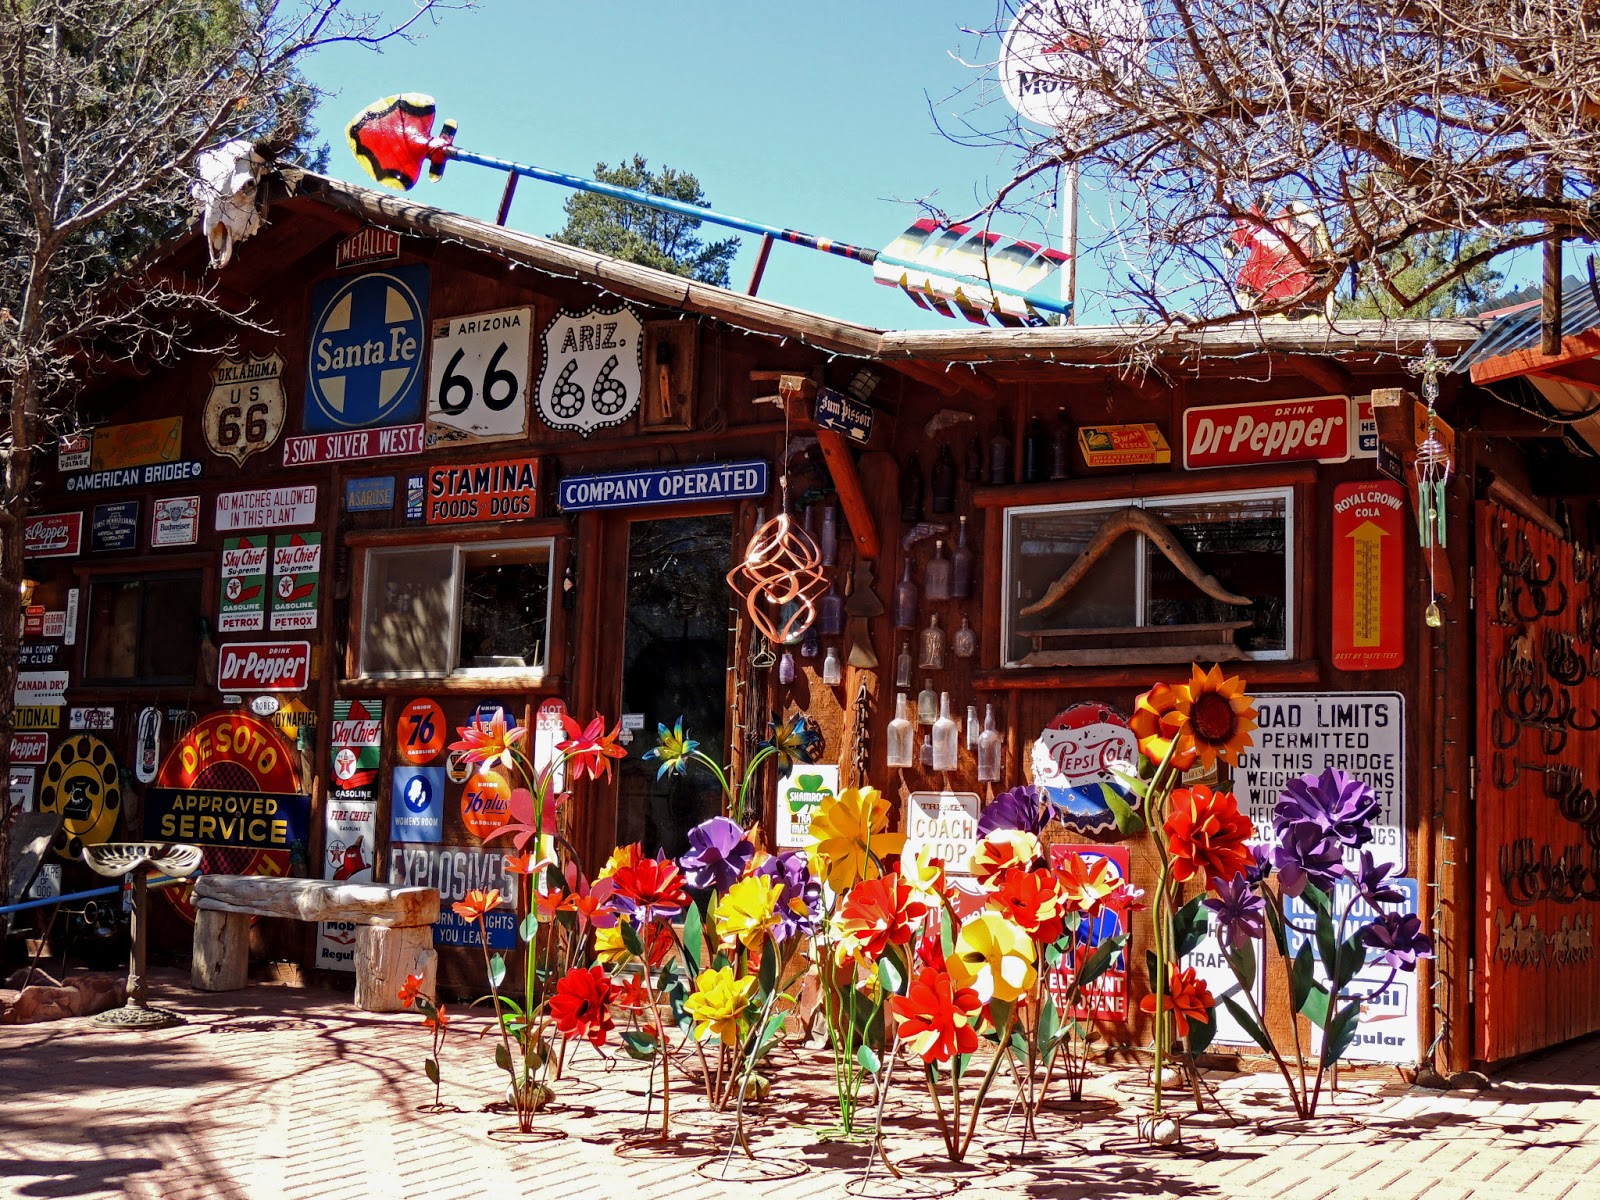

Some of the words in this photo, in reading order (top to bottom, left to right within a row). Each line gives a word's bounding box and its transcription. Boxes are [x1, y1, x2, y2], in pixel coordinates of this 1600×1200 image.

[342, 228, 394, 260] METALLIC
[458, 314, 521, 335] ARIZONA
[560, 322, 627, 353] ARIZ.
[317, 337, 385, 371] Santa
[389, 326, 417, 362] Fe
[218, 362, 278, 382] OKLAHOMA
[438, 341, 519, 416] 66
[551, 354, 628, 418] 66
[1274, 405, 1315, 417] DRINK
[219, 403, 268, 446] 66
[292, 439, 317, 463] SON
[325, 432, 368, 459] SILVER
[379, 427, 416, 452] WEST
[60, 460, 87, 468] VOLTAGE
[75, 469, 140, 492] AMERICAN
[145, 462, 191, 483] BRIDGE
[408, 477, 424, 489] PULL
[431, 463, 536, 498] STAMINA
[565, 478, 651, 504] COMPANY
[658, 468, 758, 496] OPERATED
[218, 495, 229, 511] NO
[231, 492, 271, 510] MATCHES
[274, 488, 315, 506] ALLOWED
[432, 499, 478, 520] FOODS
[491, 495, 530, 516] DOGS
[1334, 492, 1366, 513] ROYAL
[1367, 491, 1403, 511] CROWN
[230, 512, 240, 527] IN
[243, 510, 263, 526] THIS
[266, 507, 297, 524] PLANT
[1355, 508, 1380, 517] COLA
[31, 521, 68, 544] Pepper
[160, 523, 190, 531] Budweiser
[224, 552, 240, 569] Sky
[242, 549, 267, 565] Chief
[275, 549, 292, 567] Sky
[294, 546, 319, 563] Chief
[223, 603, 261, 612] GASOLINE
[275, 601, 314, 610] GASOLINE
[45, 614, 64, 623] GENERAL
[223, 618, 259, 628] PETROX
[275, 616, 312, 626] PETROX
[35, 645, 59, 653] COUNTY
[31, 655, 53, 664] CLUB
[17, 681, 47, 690] CANADA
[50, 680, 65, 690] DRY
[255, 702, 275, 711] ROBES
[541, 705, 562, 714] HOT
[1257, 704, 1301, 728] OAD
[1317, 704, 1389, 728] LIMITS
[275, 711, 316, 728] DYNAFUEL
[406, 711, 436, 746] 76
[538, 720, 563, 729] COLD
[332, 720, 351, 746] Sky
[351, 720, 382, 742] Chief
[1262, 733, 1369, 748] PERMITTED
[10, 738, 46, 759] Pepper
[1238, 753, 1261, 769] ON
[1272, 753, 1312, 769] THIS
[1324, 753, 1394, 770] BRIDGE
[335, 790, 372, 798] GASOLINE
[465, 791, 484, 814] 76
[481, 794, 509, 814] plus
[172, 795, 278, 815] APPROVED
[331, 810, 348, 820] FIRE
[350, 811, 373, 822] CHIEF
[395, 817, 420, 826] WOMEN'S
[421, 817, 438, 827] ROOM
[797, 813, 812, 823] TRA
[161, 814, 288, 844] SERVICE
[791, 824, 809, 834] MAS
[916, 819, 973, 839] COACH
[922, 843, 967, 863] TOP
[389, 848, 514, 903] EXPLOSIVES
[326, 921, 356, 931] Mob
[485, 915, 514, 930] IGHTS
[440, 929, 459, 943] YOU
[321, 947, 355, 962] Regul
[1188, 952, 1231, 968] TRAF
[1050, 992, 1124, 1013] KEOSENE
[1338, 984, 1400, 1007] obil
[1351, 1031, 1406, 1047] gular
